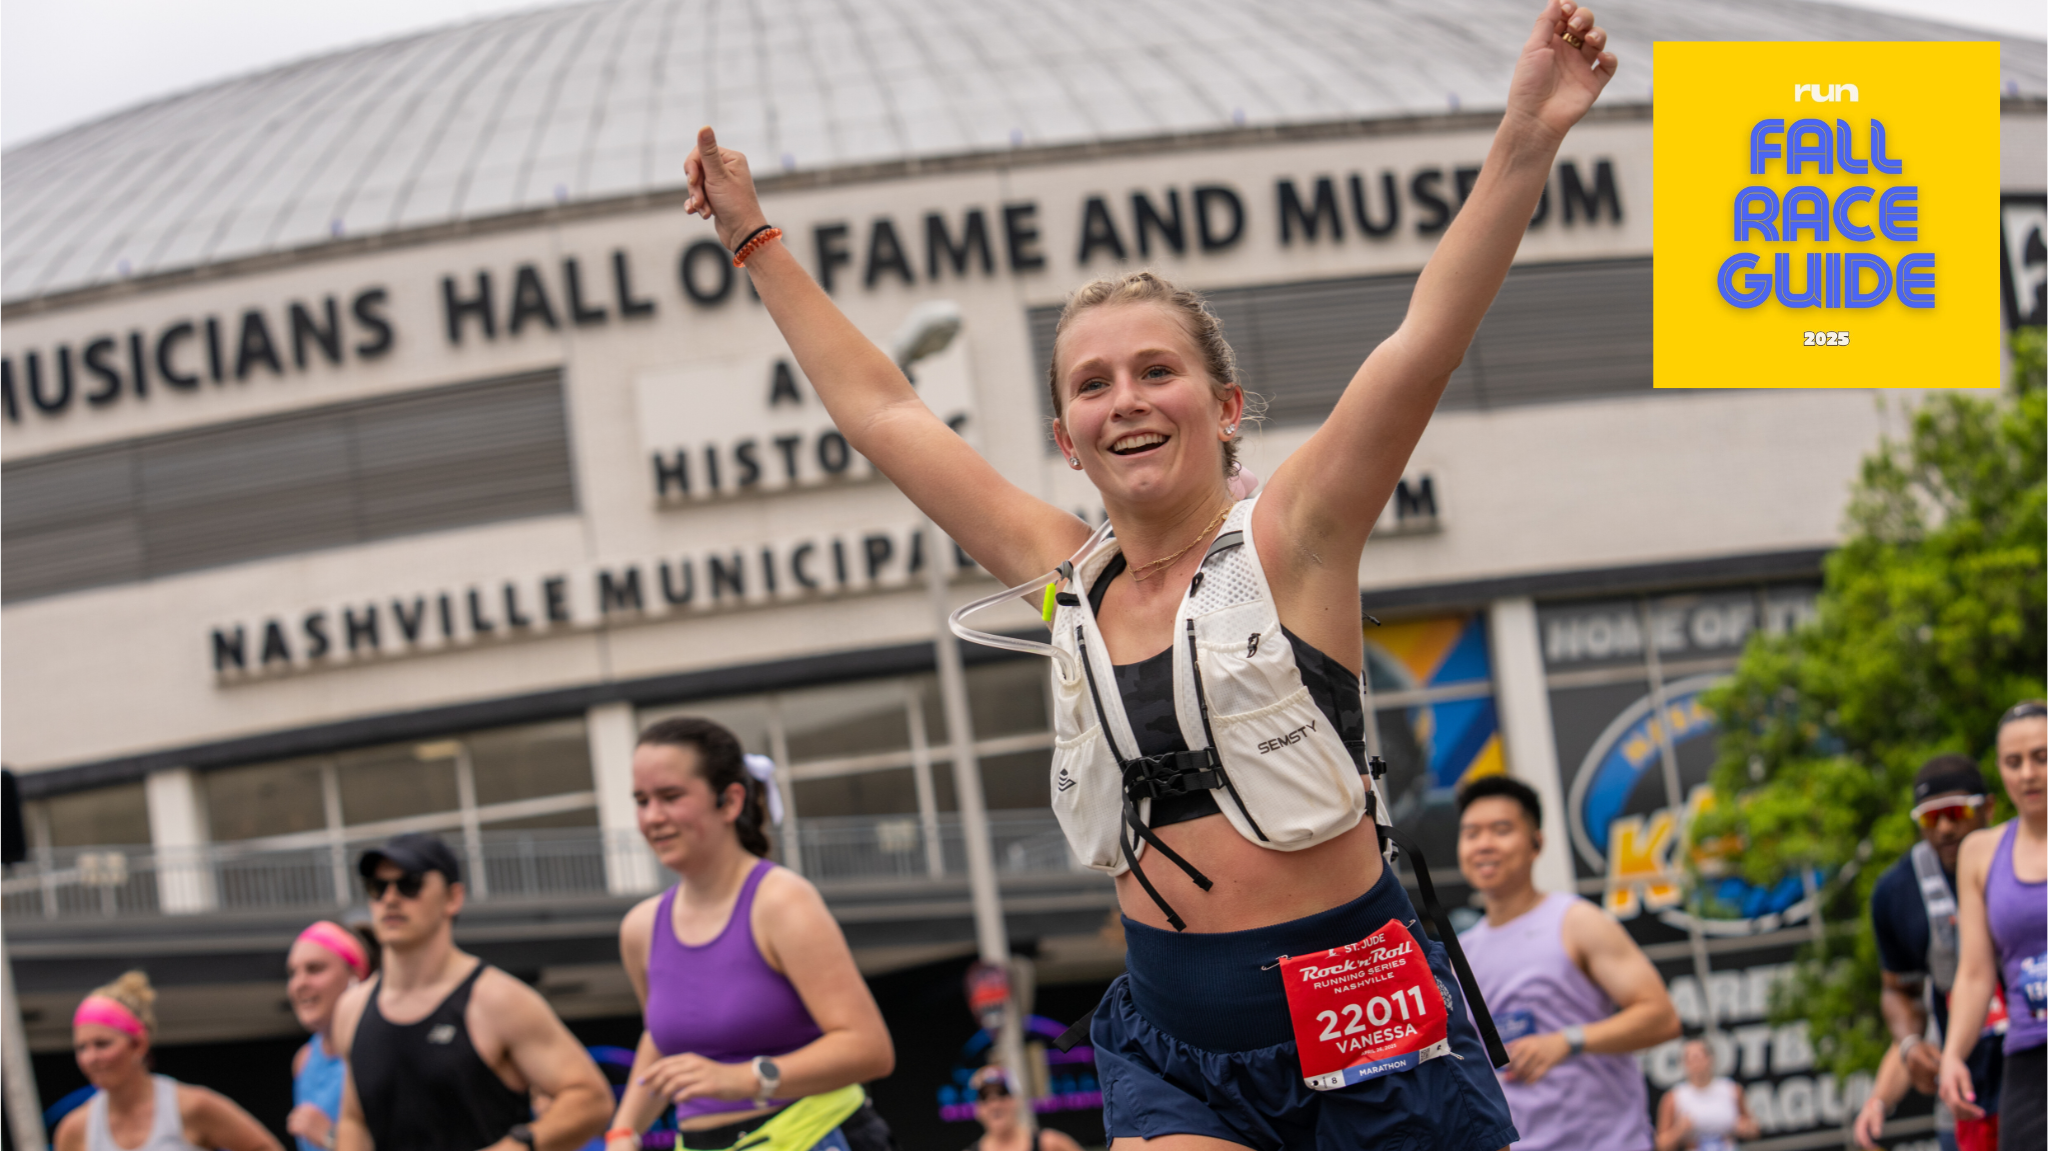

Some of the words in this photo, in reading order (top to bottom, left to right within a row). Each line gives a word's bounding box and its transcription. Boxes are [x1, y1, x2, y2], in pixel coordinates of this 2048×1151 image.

[441, 250, 656, 346] HALL
[813, 202, 1047, 294] FAME
[1077, 183, 1246, 266] AND
[211, 577, 569, 673] NASHVILLE
[1257, 719, 1317, 755] SEMSTY
[1361, 933, 1386, 949] JUDE
[1313, 970, 1366, 990] RUNNING
[1367, 958, 1407, 976] SERIES
[1334, 971, 1394, 994] NASHVILLE
[1315, 985, 1427, 1042] 22011
[1335, 1022, 1418, 1054] VANESSA
[1359, 1059, 1407, 1077] MARATHON
